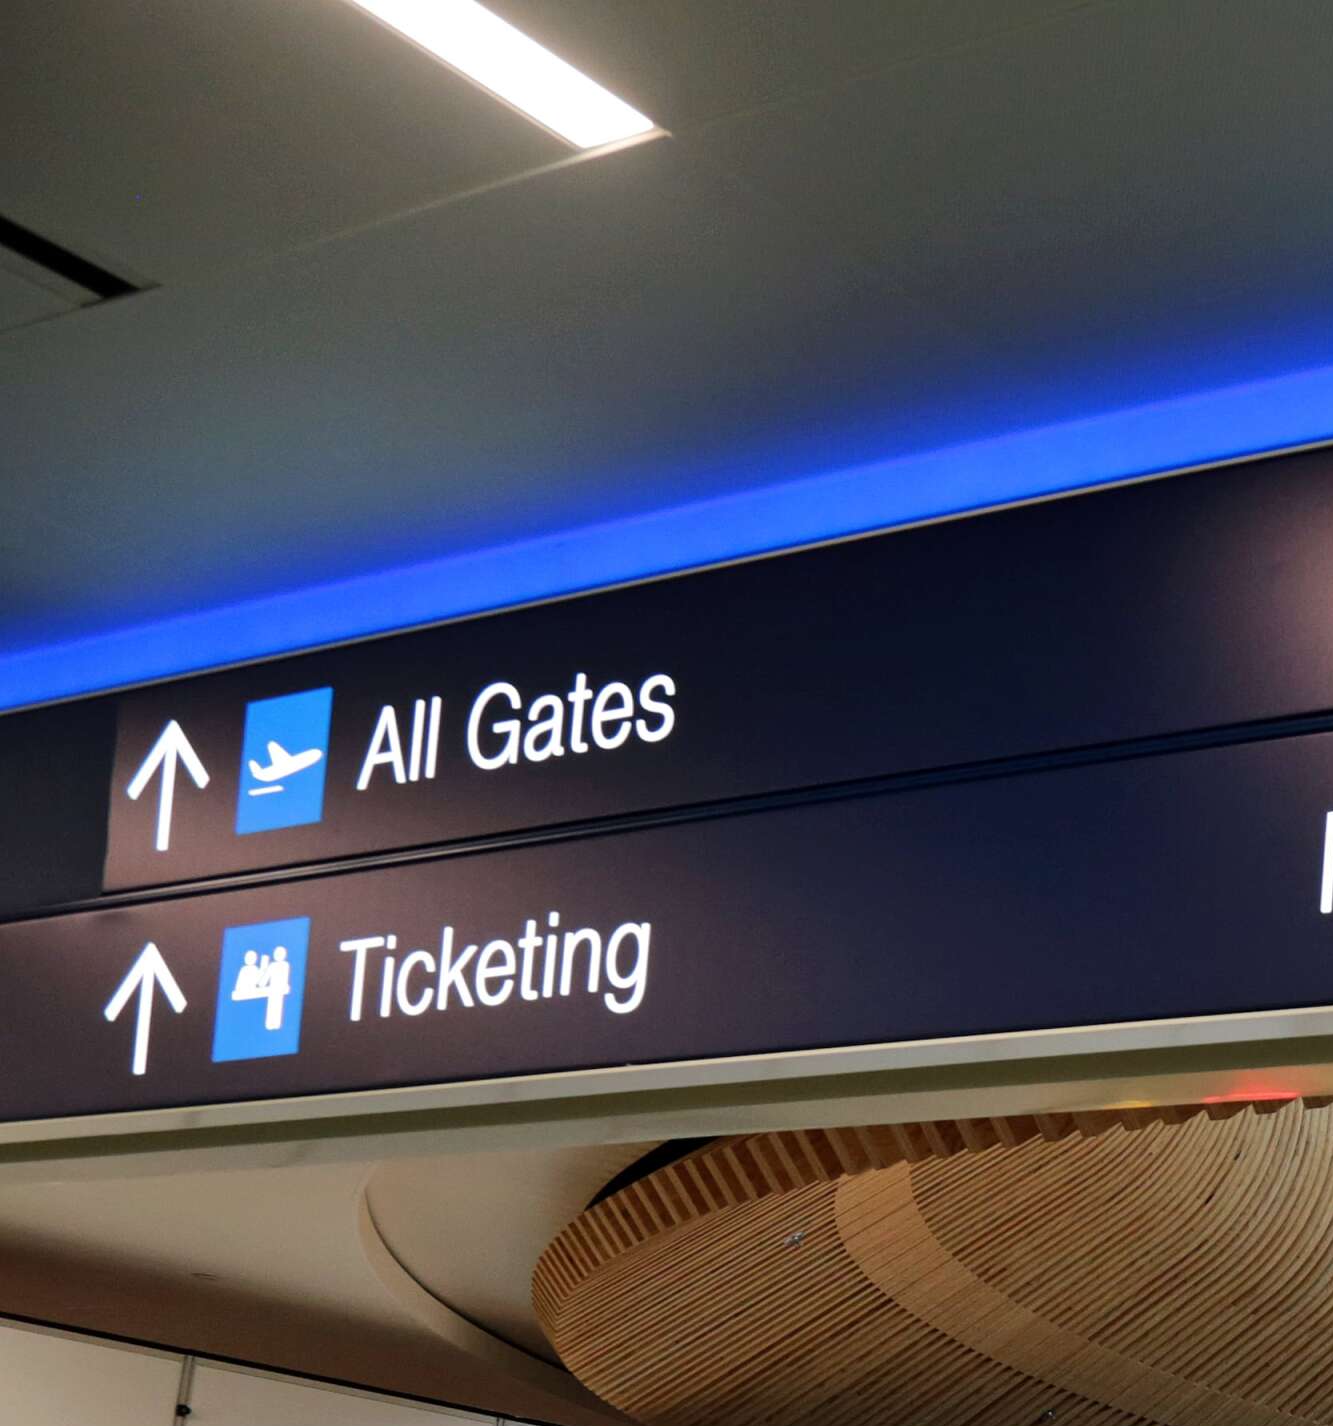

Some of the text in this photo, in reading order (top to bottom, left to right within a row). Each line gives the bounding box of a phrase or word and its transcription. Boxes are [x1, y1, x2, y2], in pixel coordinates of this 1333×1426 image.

[356, 672, 676, 791] All Gates
[339, 911, 652, 1014] Ticketing
